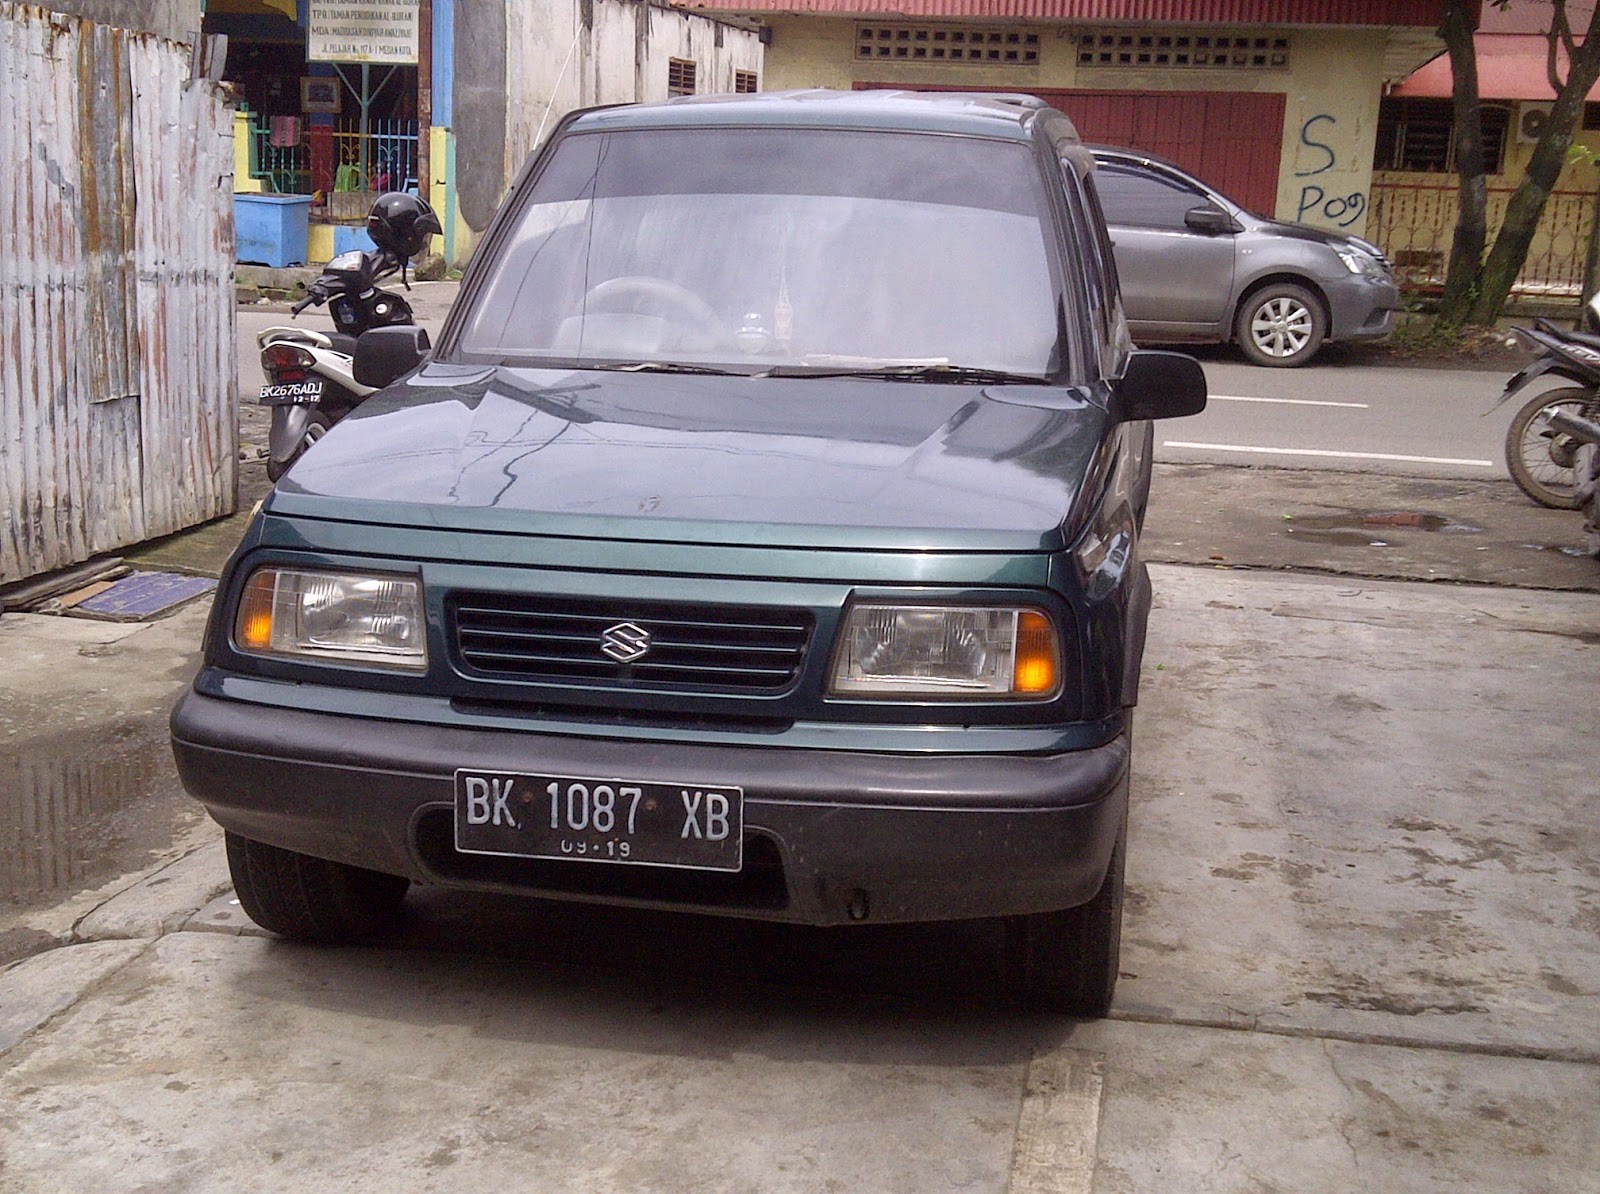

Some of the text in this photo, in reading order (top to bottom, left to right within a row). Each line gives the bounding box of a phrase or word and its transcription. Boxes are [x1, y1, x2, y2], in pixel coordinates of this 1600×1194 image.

[1294, 114, 1336, 177] S
[546, 782, 642, 835] 1087
[681, 790, 730, 841] XB
